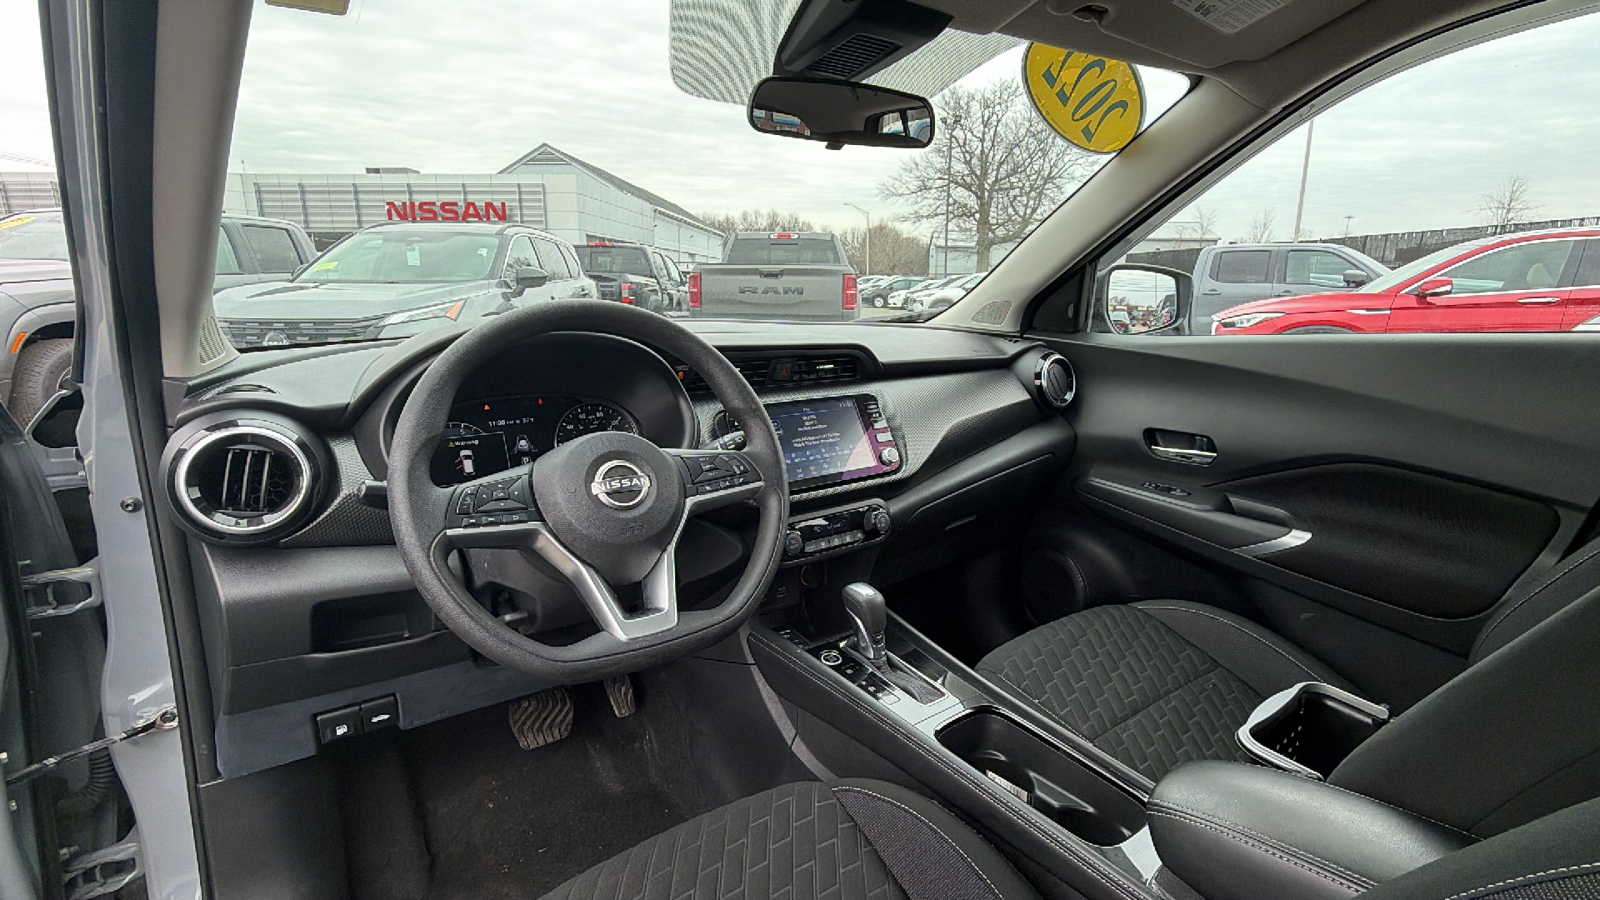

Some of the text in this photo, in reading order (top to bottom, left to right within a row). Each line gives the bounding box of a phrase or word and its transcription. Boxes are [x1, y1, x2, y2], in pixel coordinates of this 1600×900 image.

[385, 201, 508, 221] NISSAN
[738, 286, 804, 296] RAM
[594, 477, 649, 491] NISSAN
